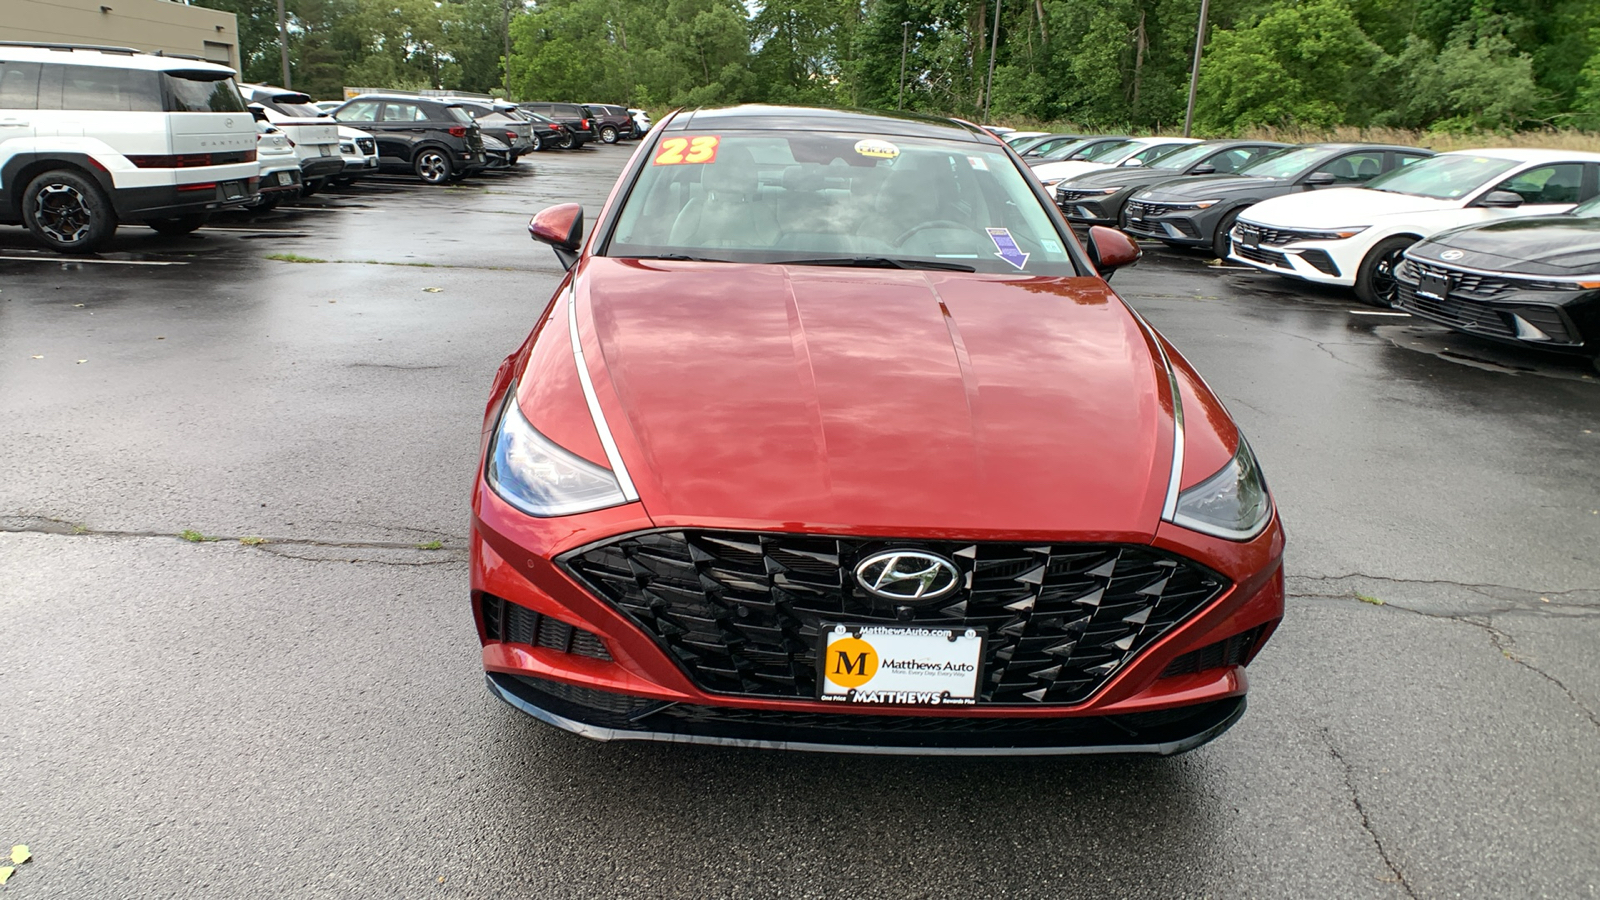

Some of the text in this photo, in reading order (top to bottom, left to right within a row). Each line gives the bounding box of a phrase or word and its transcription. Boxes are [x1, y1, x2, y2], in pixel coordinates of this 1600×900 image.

[655, 136, 718, 164] 23
[859, 626, 952, 637] MatthewsAuto.com
[832, 650, 871, 676] M
[881, 658, 975, 672] Matthews Auto
[821, 694, 833, 702] One
[852, 690, 942, 705] MATTHEWS
